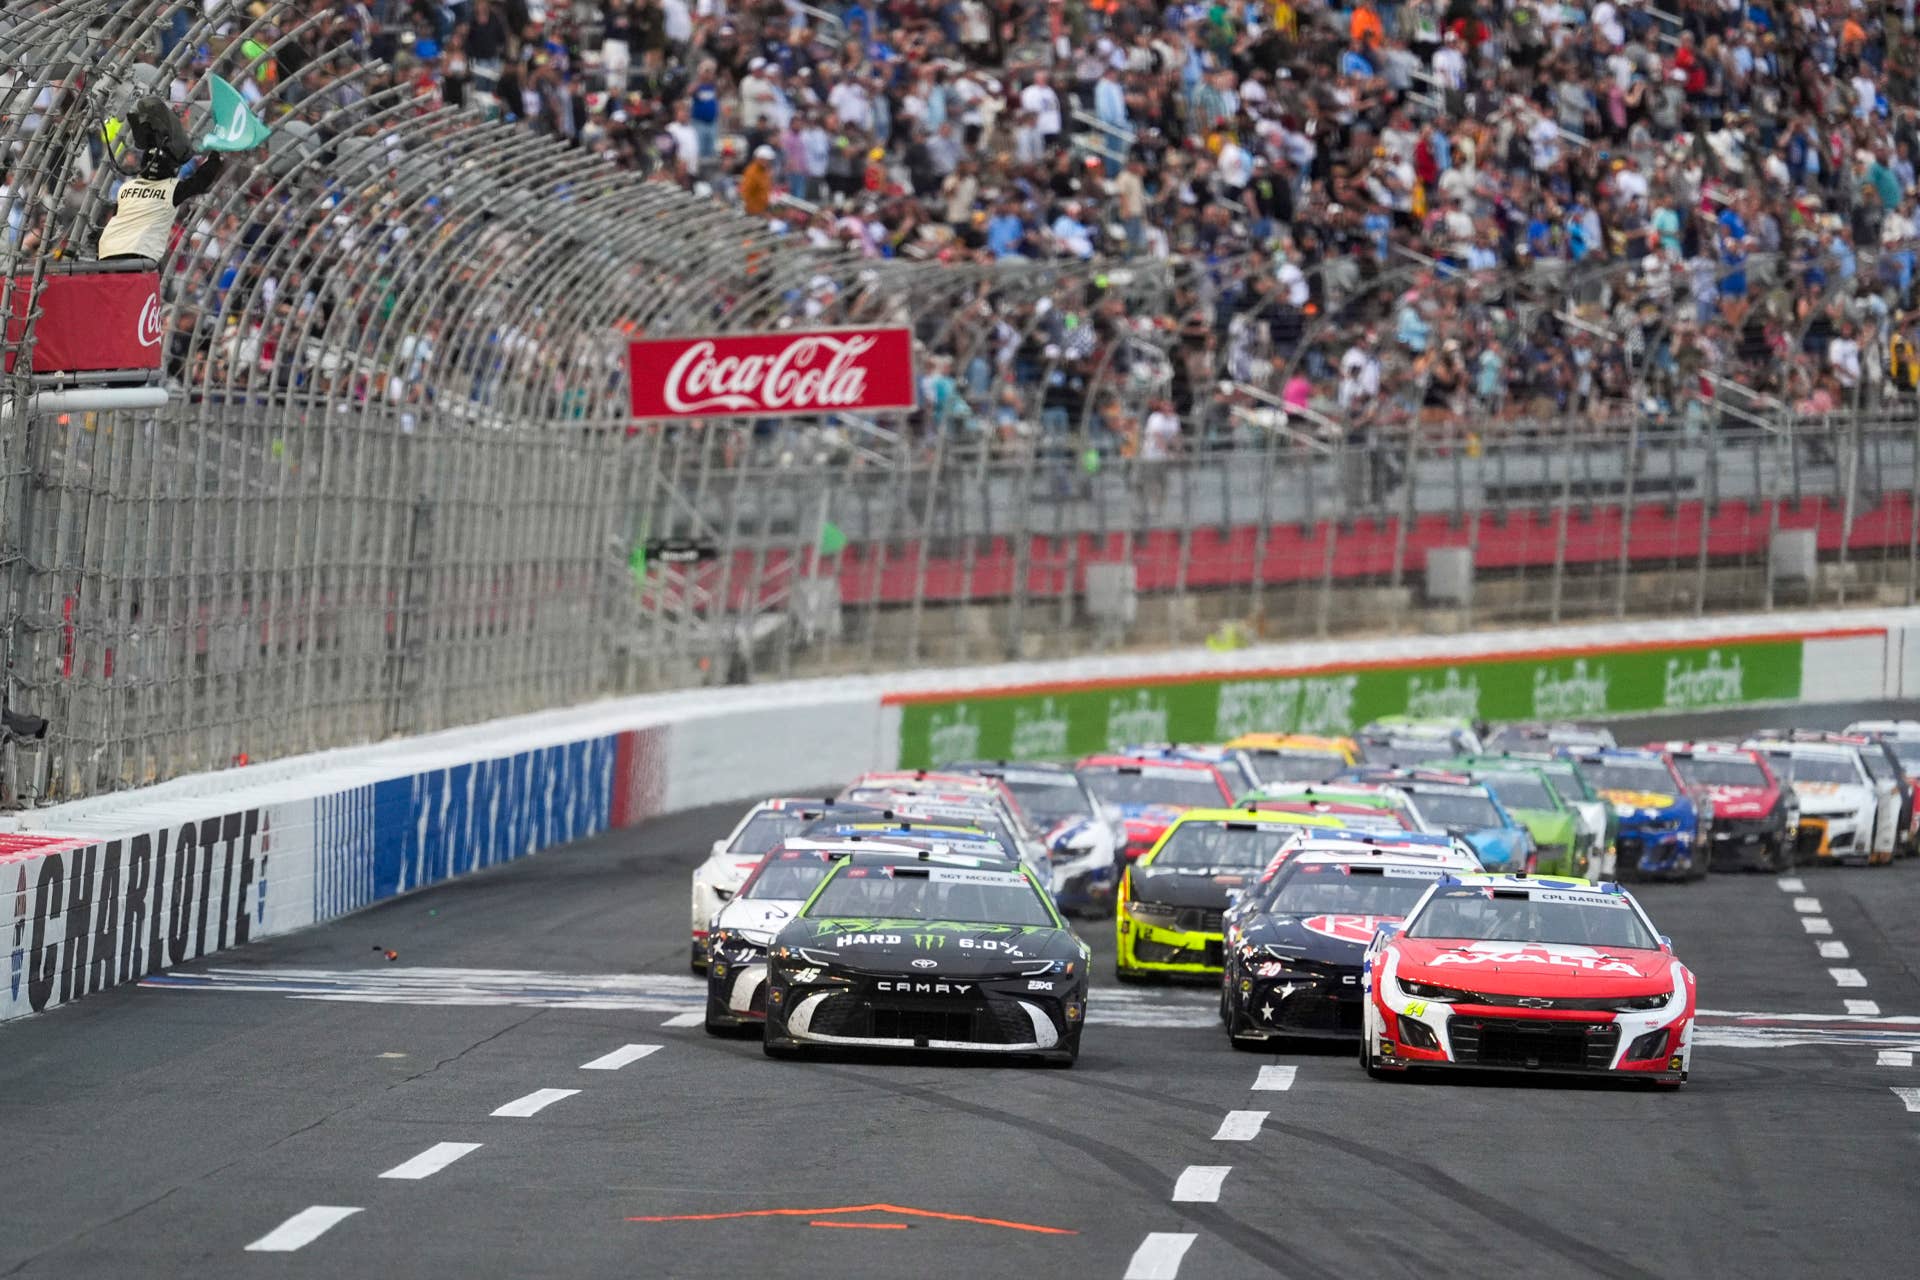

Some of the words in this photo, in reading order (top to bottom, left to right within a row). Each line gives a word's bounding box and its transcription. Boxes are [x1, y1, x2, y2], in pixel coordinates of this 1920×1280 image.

[121, 188, 166, 200] OFFICIAL
[664, 334, 877, 412] Coca-Cola
[1542, 893, 1565, 902] CPL
[28, 808, 260, 1012] CHARLOTTE
[836, 934, 901, 948] HARD
[959, 938, 1024, 958] 6.0%
[1257, 962, 1282, 977] 20
[1428, 952, 1641, 977] AXALTA
[793, 967, 822, 983] 45
[878, 981, 971, 994] CAMRY
[1403, 1001, 1428, 1017] 24
